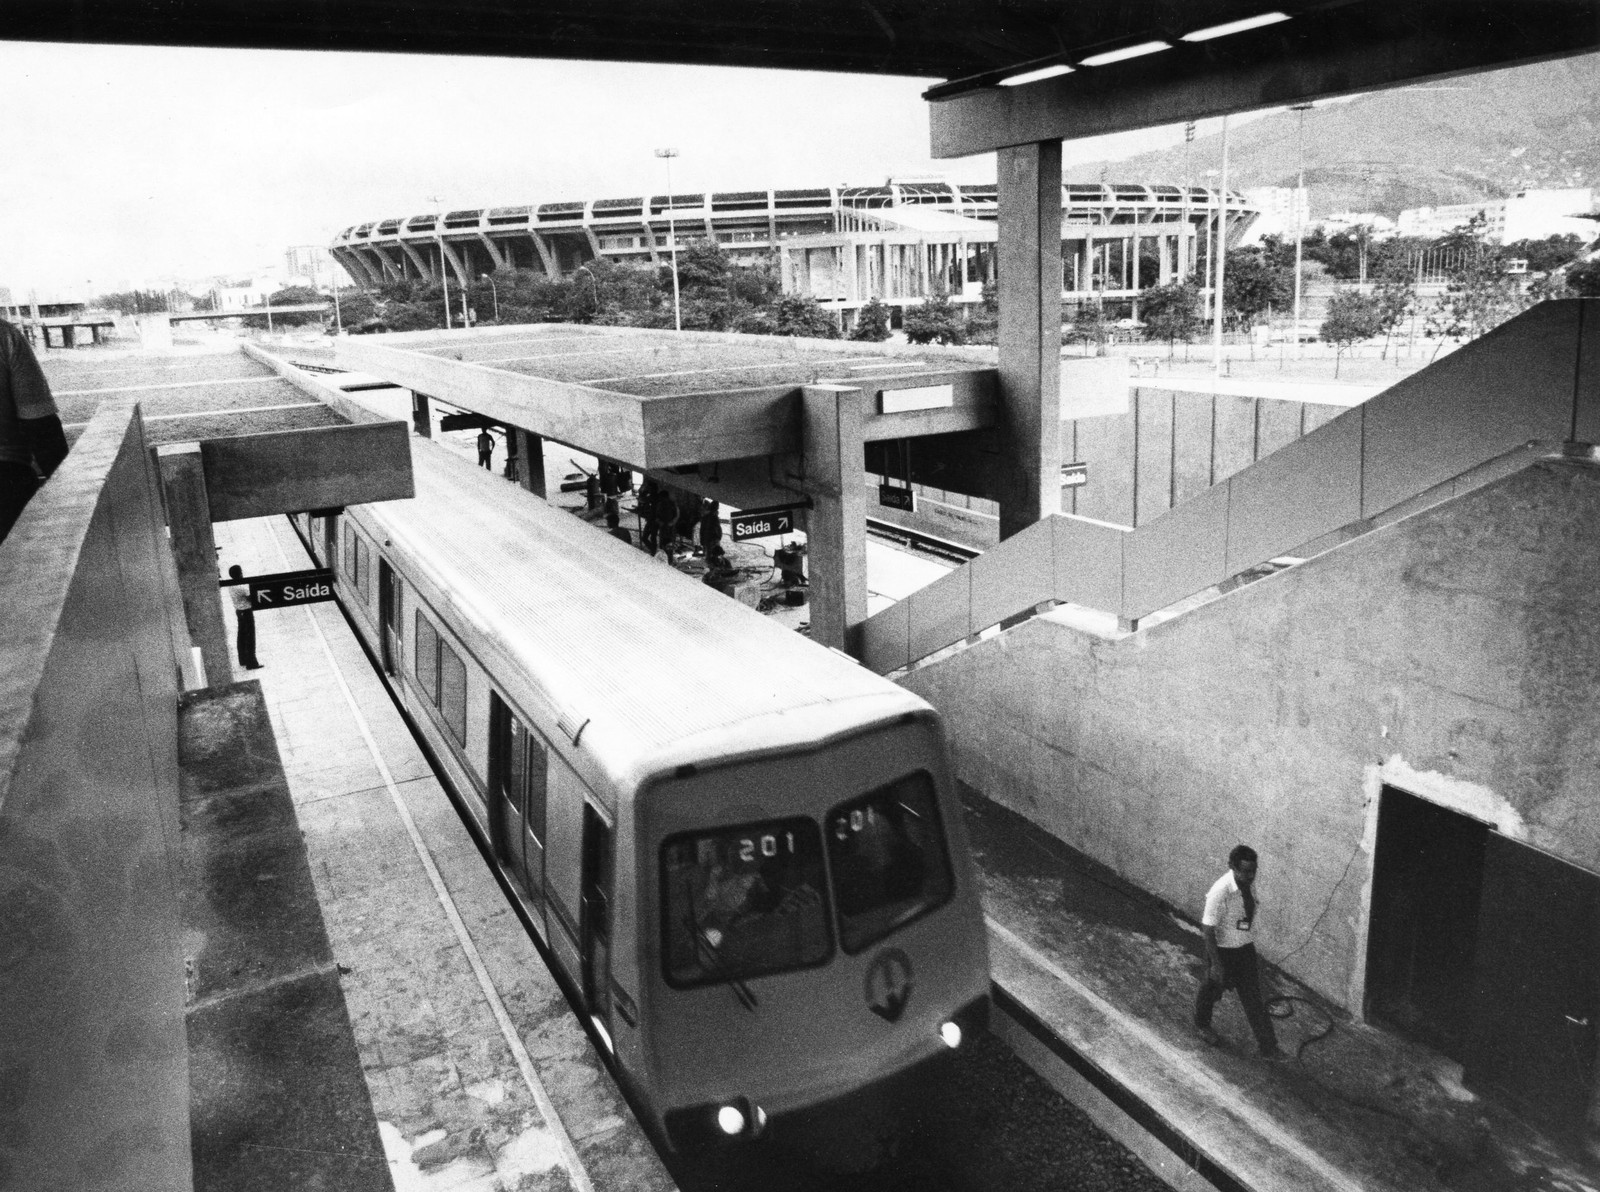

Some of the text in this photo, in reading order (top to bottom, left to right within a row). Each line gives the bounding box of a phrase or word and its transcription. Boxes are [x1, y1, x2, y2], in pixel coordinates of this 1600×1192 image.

[736, 520, 771, 536] Saída
[283, 583, 330, 601] Saída
[739, 831, 794, 862] 201
